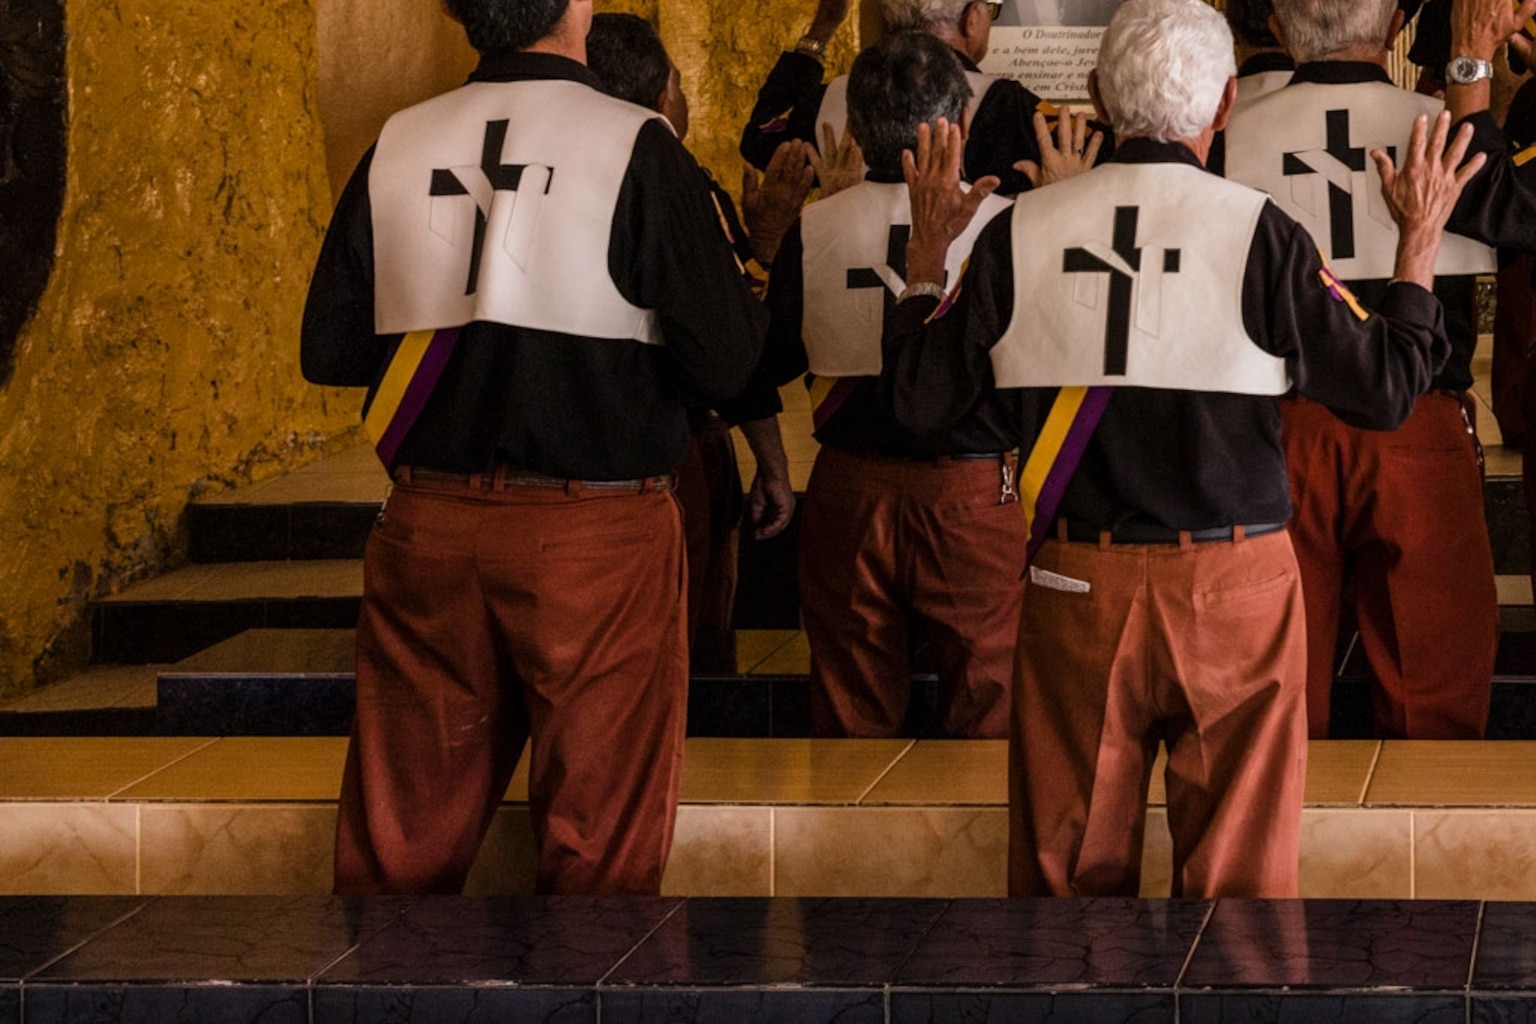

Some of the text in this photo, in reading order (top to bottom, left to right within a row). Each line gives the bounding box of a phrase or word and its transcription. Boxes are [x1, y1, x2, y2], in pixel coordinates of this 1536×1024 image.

[1022, 30, 1032, 38] O
[1014, 46, 1039, 54] bem
[1074, 58, 1096, 66] Jes
[1055, 82, 1088, 92] Crist
